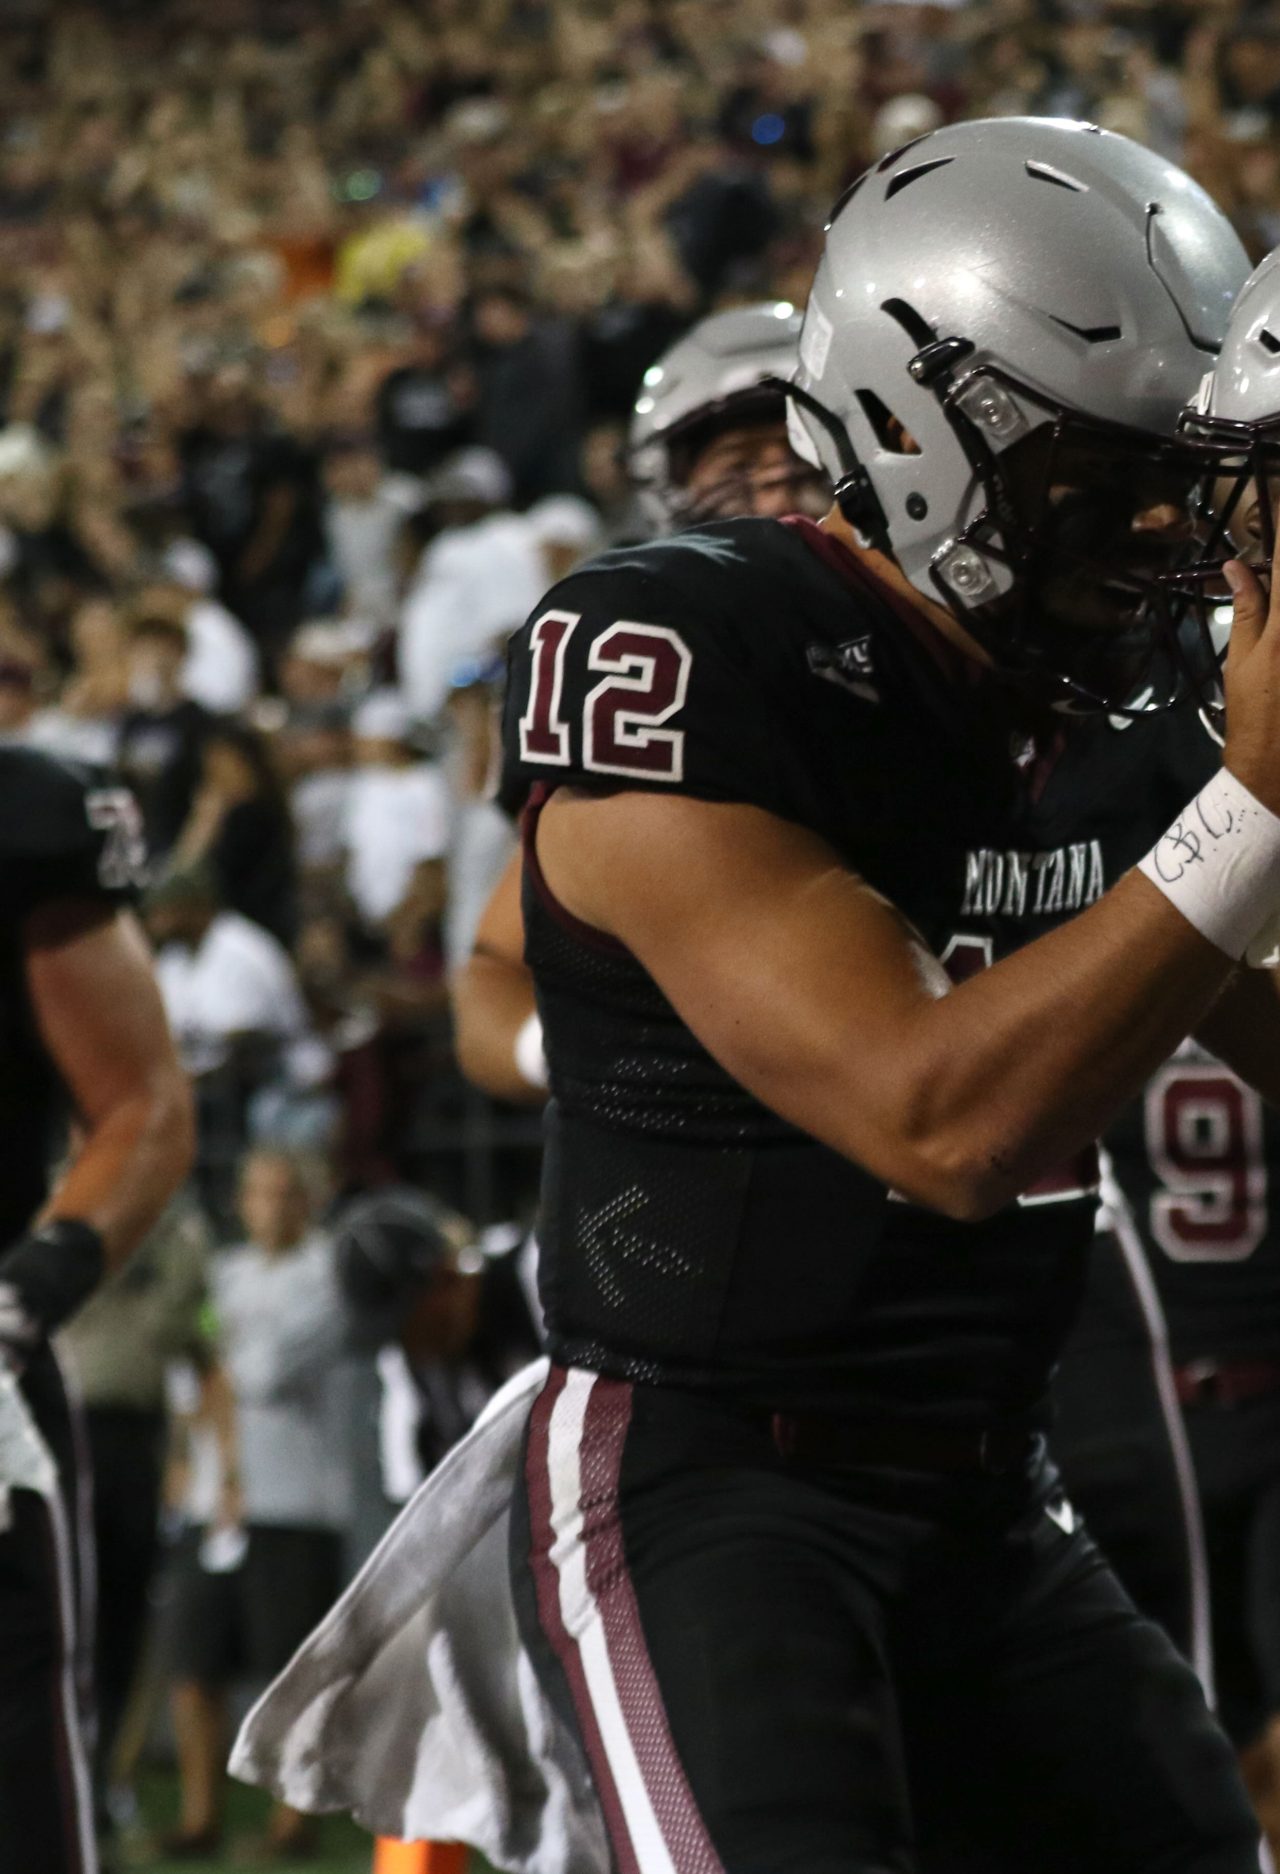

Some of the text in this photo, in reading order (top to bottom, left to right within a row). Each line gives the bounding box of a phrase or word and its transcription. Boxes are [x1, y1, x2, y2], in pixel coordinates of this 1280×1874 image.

[519, 609, 693, 782] 12
[960, 839, 1105, 917] MONTANA
[1144, 1064, 1268, 1263] 9
